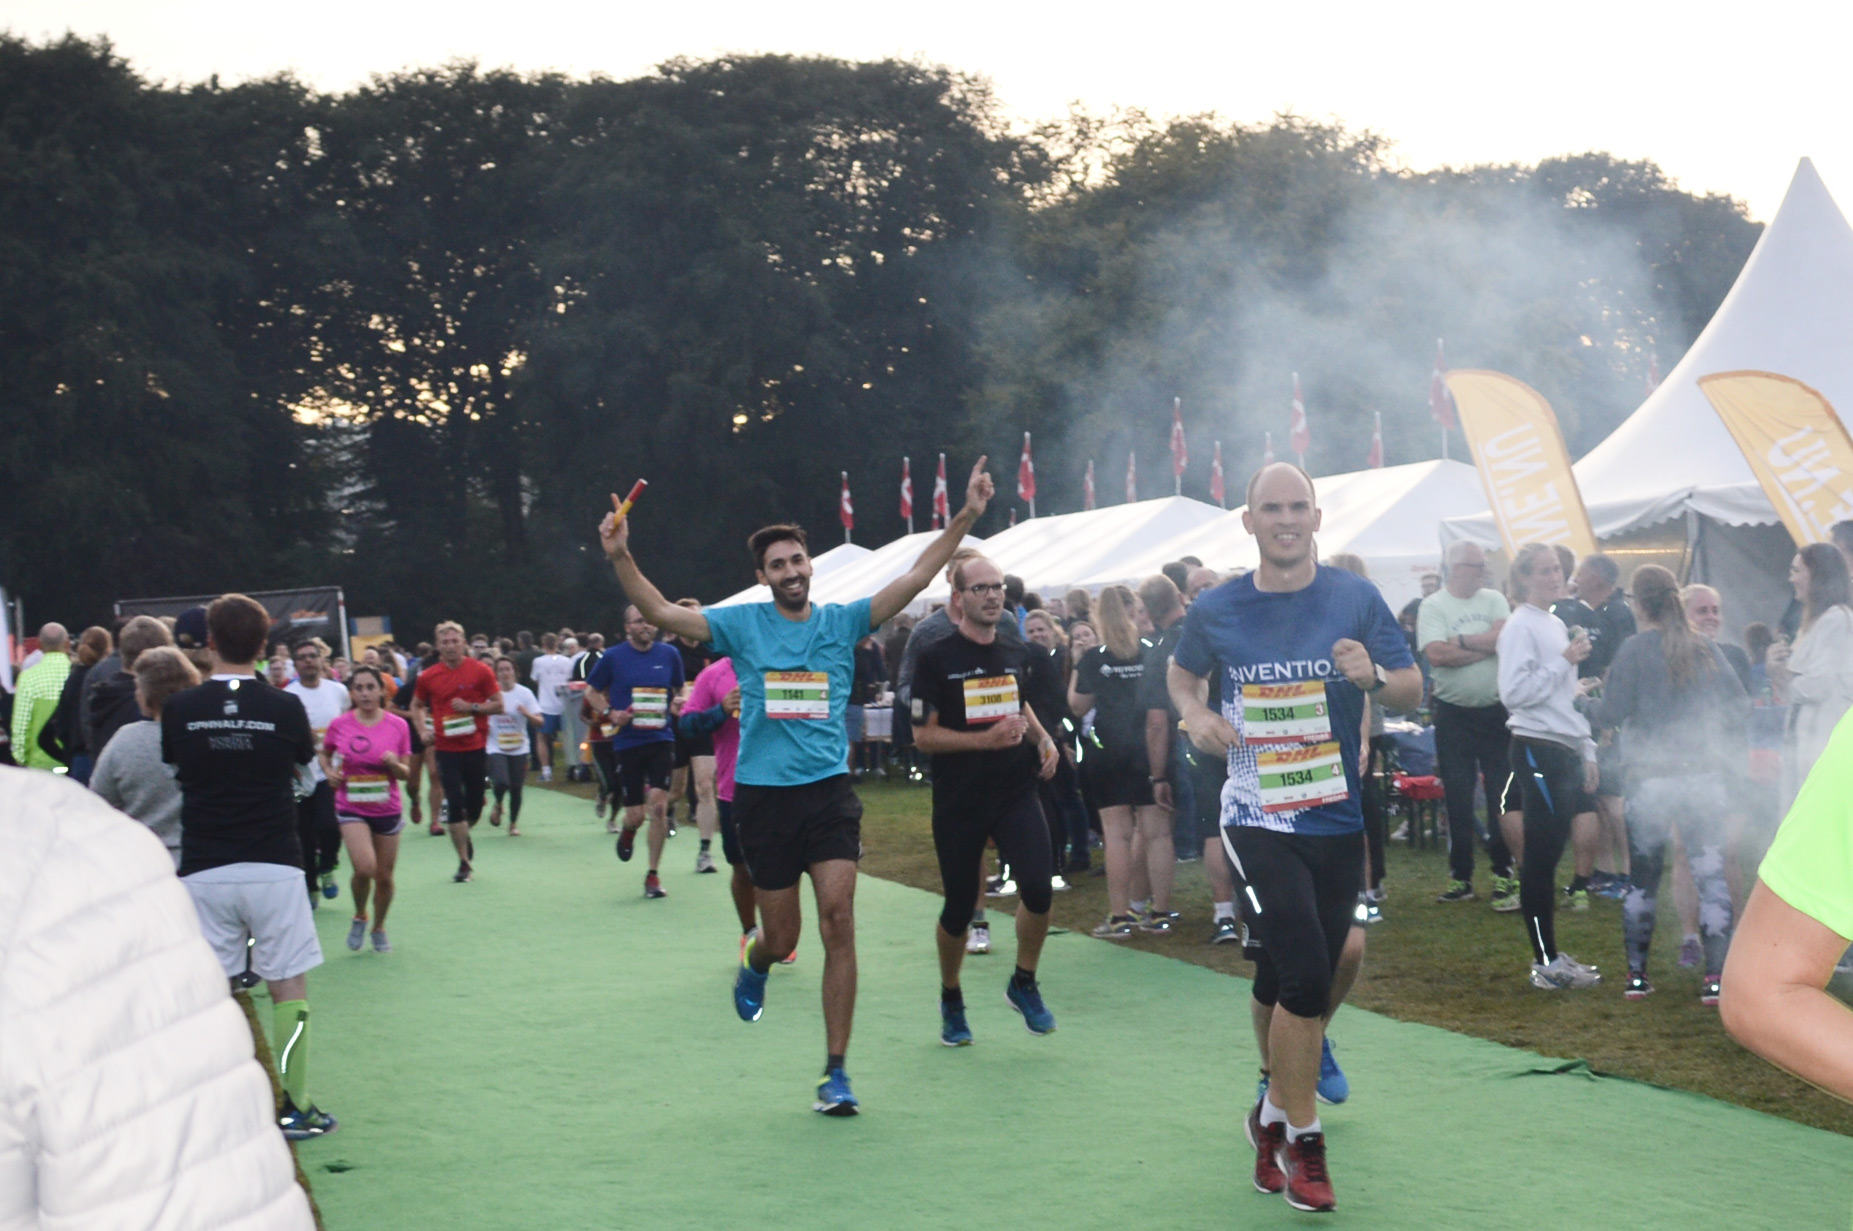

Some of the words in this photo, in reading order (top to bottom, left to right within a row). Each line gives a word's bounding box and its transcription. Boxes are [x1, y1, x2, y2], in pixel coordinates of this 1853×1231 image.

[779, 672, 816, 681] DHL
[978, 675, 1009, 688] DHL
[783, 689, 804, 700] 1141
[1259, 684, 1306, 698] DHL
[1262, 706, 1294, 721] 1534
[1316, 703, 1325, 716] 3
[1274, 745, 1322, 763] DHL
[1280, 769, 1313, 787] 1534
[1331, 763, 1340, 776] 4
